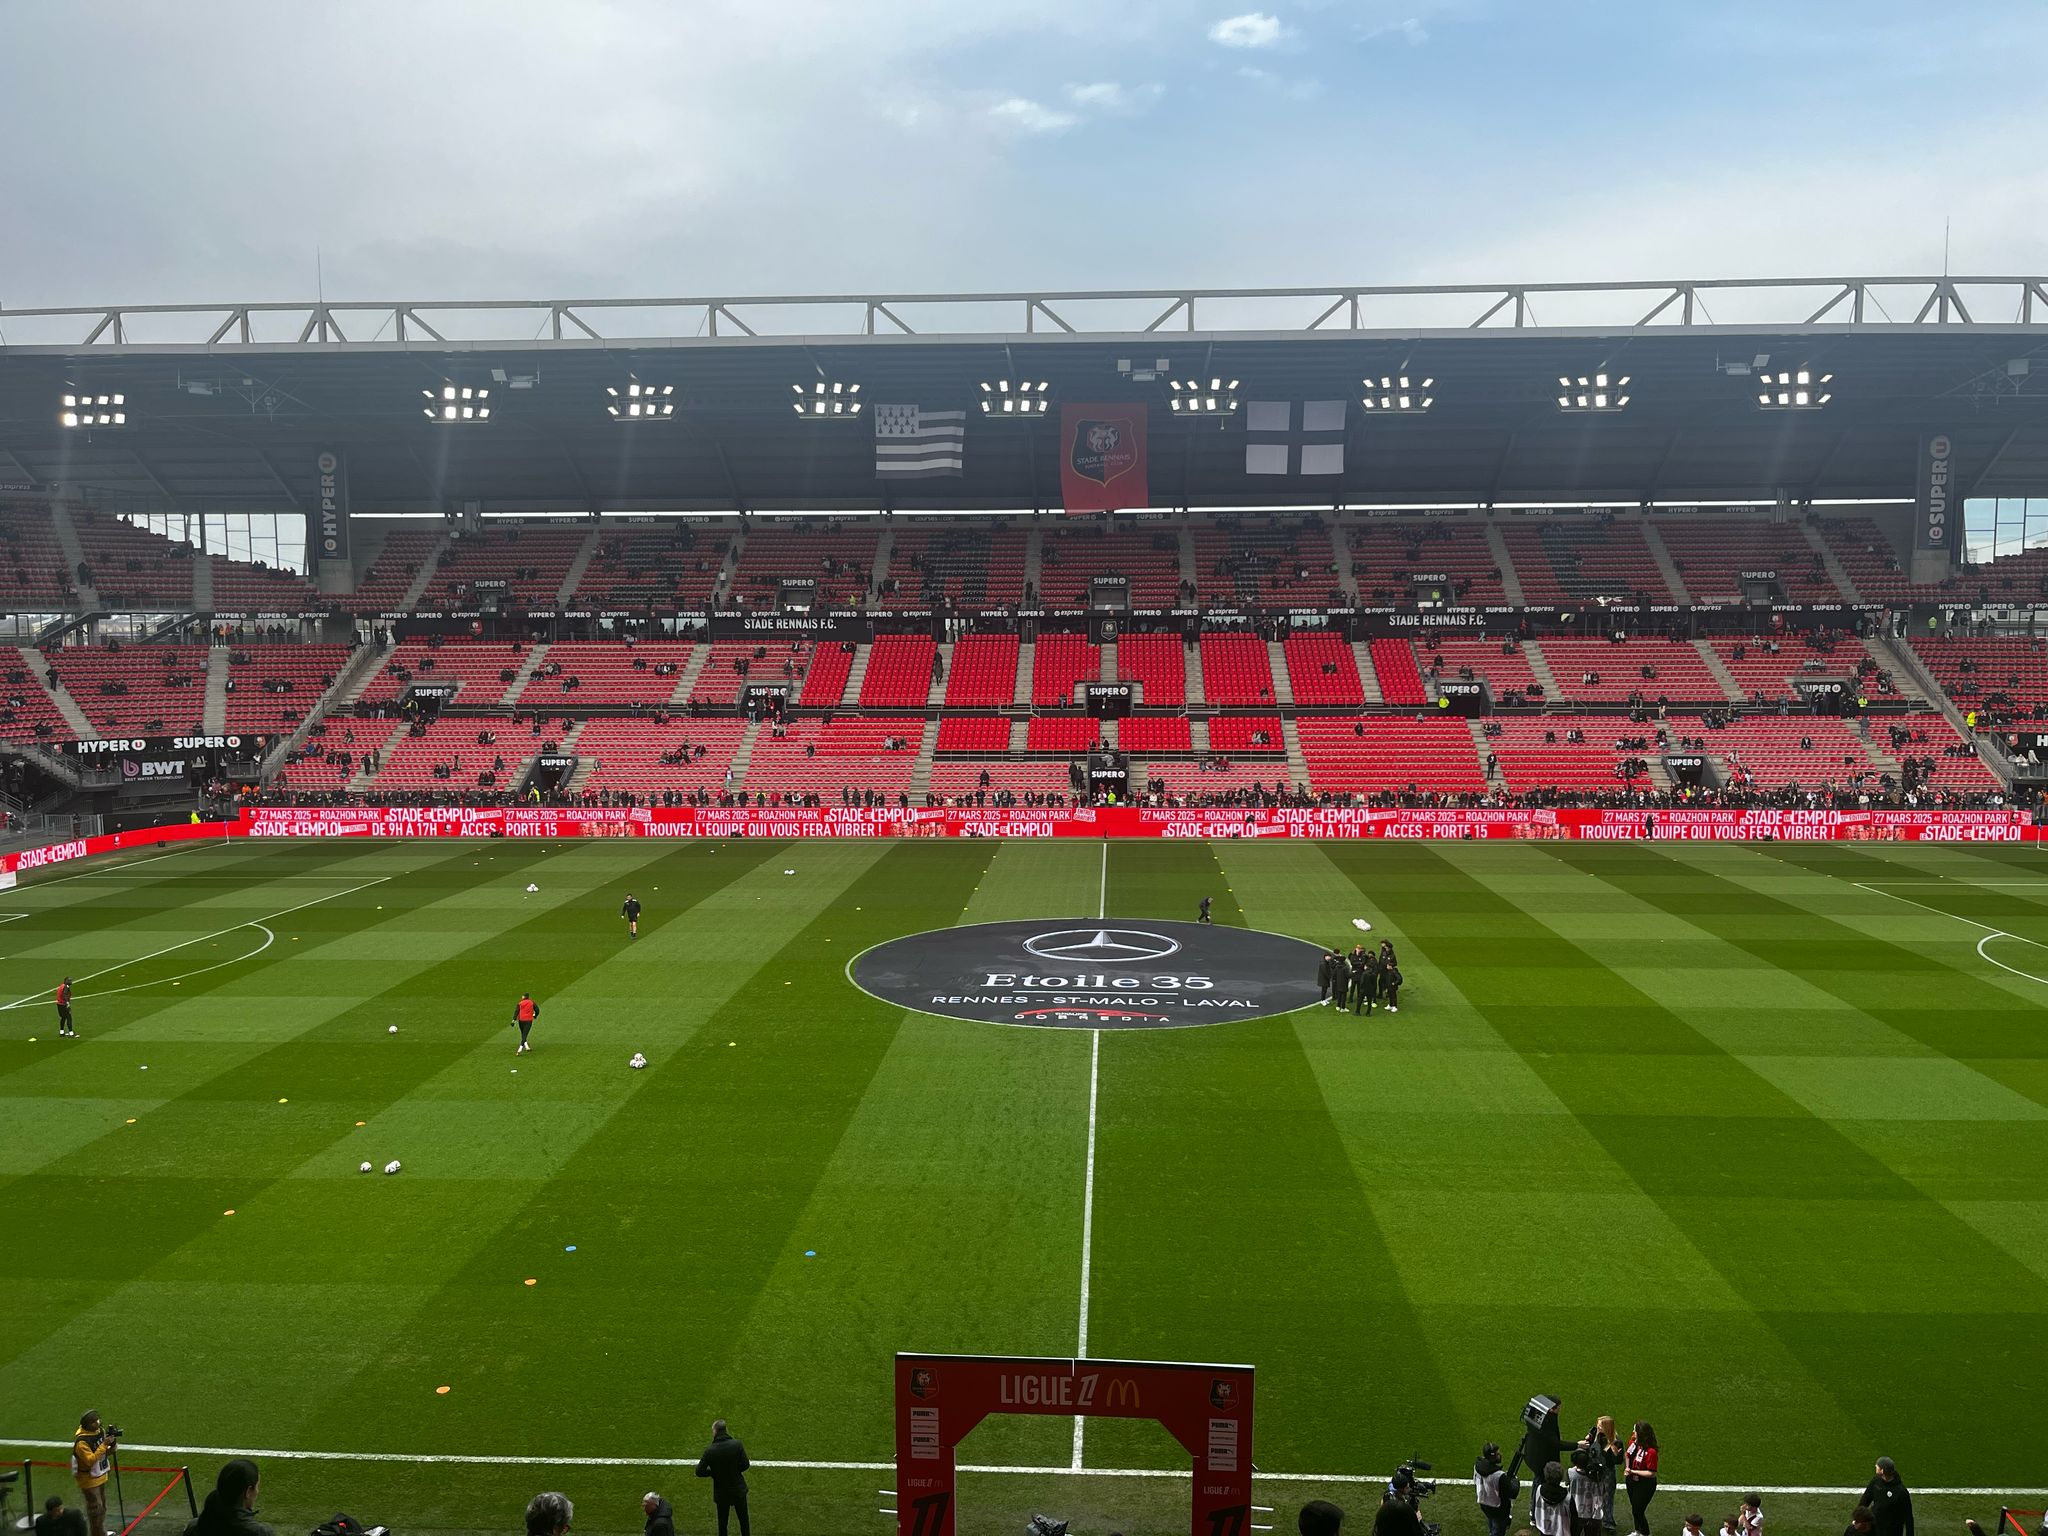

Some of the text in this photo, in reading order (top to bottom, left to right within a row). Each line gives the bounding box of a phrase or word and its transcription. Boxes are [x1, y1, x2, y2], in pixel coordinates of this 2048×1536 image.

[744, 619, 837, 629] STADE RENNAIS F.C.
[1389, 614, 1486, 626] STADE RENNAIS F.C.
[415, 689, 444, 697] SUPER
[1090, 687, 1119, 695] SUPER
[78, 741, 130, 753] HYPER
[173, 737, 225, 749] SUPER
[142, 760, 185, 775] BWT
[259, 810, 379, 820] 27 MARS 2025 ROAZHON PARK
[389, 808, 474, 823] STADE L'EMPLOI
[505, 810, 514, 821] 27
[515, 810, 538, 821] MARS
[539, 811, 558, 821] 2025
[566, 811, 603, 821] ROAZHON
[605, 811, 626, 821] PARK
[697, 811, 818, 821] 27 MARS 2025 ROAZHON PARK
[830, 809, 915, 823] STADE L'EMPLOI
[947, 811, 957, 822] 27
[958, 811, 982, 822] MARS
[983, 811, 1000, 822] 2025
[1009, 811, 1046, 822] ROAZHON
[1049, 811, 1070, 822] PARK
[1142, 811, 1267, 822] 27 MARS 2025 ROAZHON PRK
[1278, 810, 1367, 824] STADE L'EMPLOI
[1401, 812, 1529, 823] 27 MARS 2025 ROAZHON PARK
[1604, 812, 1734, 823] 27 MARS ROAZHON PARK
[1745, 810, 1838, 825] STADE L'EMPLOI
[1874, 813, 1884, 824] 27
[1886, 813, 1911, 824] MARS
[1913, 813, 1932, 824] 2025
[1942, 813, 1982, 824] ROAZHON
[1985, 813, 2008, 824] PARK
[254, 822, 340, 836] STADE L'EMPLOI
[372, 823, 386, 836] DE
[388, 823, 404, 836] 9H
[417, 823, 437, 836] 17H
[506, 823, 541, 837] PORTE
[545, 823, 557, 837] 15
[643, 824, 692, 837] TROUVEZ
[748, 824, 767, 837] QUI
[770, 824, 800, 837] VOUS
[803, 824, 831, 837] FERA
[833, 824, 875, 837] VIBRER
[965, 824, 1053, 838] STADE L'EMPLOI
[1168, 824, 1256, 839] STADE L'EMPLOI
[1290, 825, 1305, 838] DE
[1307, 825, 1324, 838] 9H
[1337, 825, 1359, 838] 17H
[1432, 825, 1470, 839] PORTE
[1474, 825, 1488, 839] 15
[1579, 825, 1828, 839] TROUVEZ L'QUIPE QUI VOUS FERA VIBRER
[1926, 826, 2021, 840] STADE L'EMPLOI
[21, 840, 87, 869] STADE L'EMPLOI
[980, 973, 1215, 990] Etoile 35
[932, 995, 1260, 1008] RENNES ST-MALO LAVAL
[1000, 1374, 1073, 1406] LIGUE
